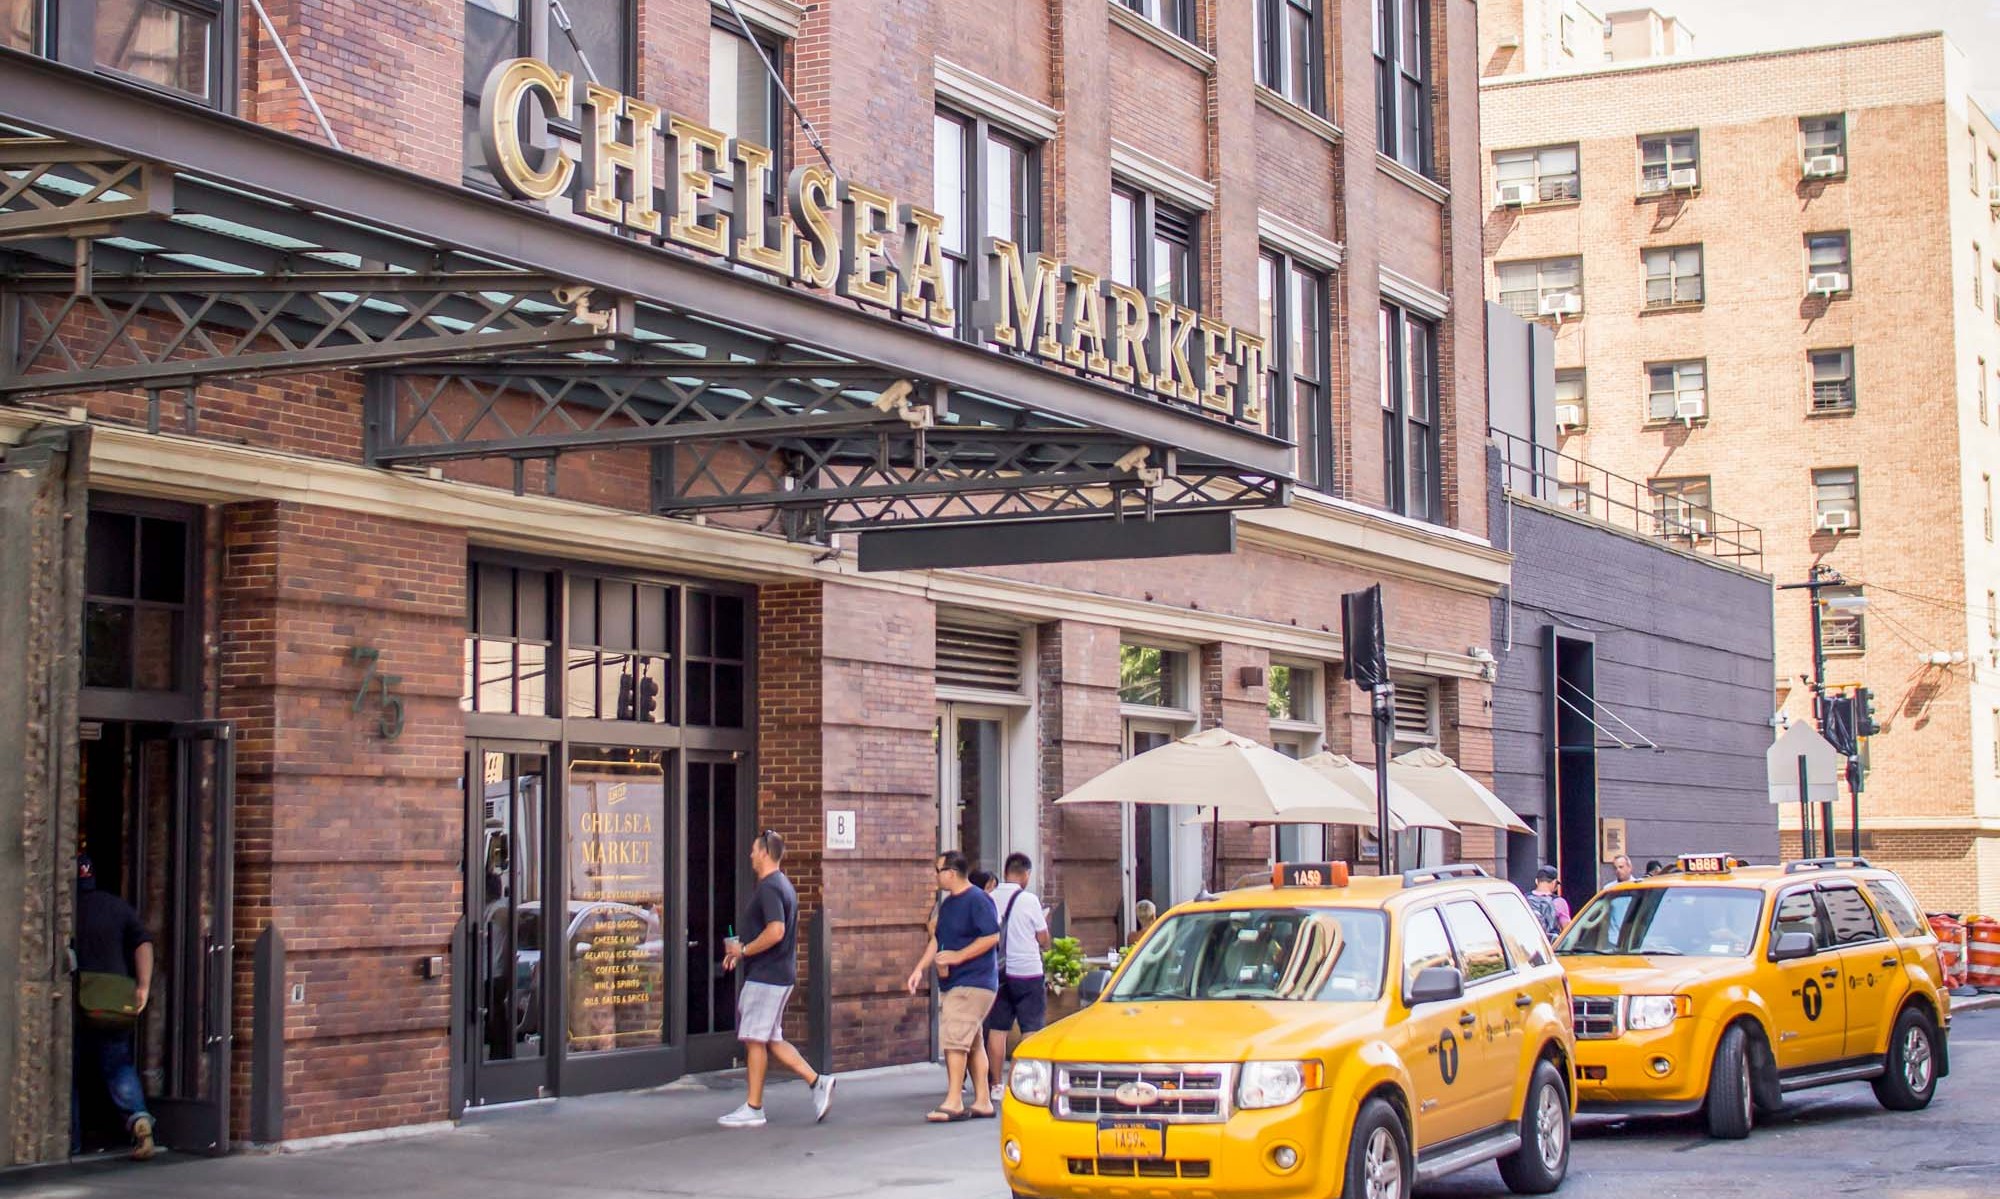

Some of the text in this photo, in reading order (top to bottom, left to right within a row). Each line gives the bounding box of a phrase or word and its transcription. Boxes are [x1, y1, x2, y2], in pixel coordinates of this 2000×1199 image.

[480, 57, 1267, 425] CHELSEA MARKET
[352, 646, 404, 741] 75
[581, 812, 651, 834] CHELSEA
[838, 815, 845, 835] B
[582, 840, 650, 865] MARKET
[1293, 869, 1322, 886] 1A59
[616, 950, 626, 958] ICE
[595, 965, 620, 975] COFFEE
